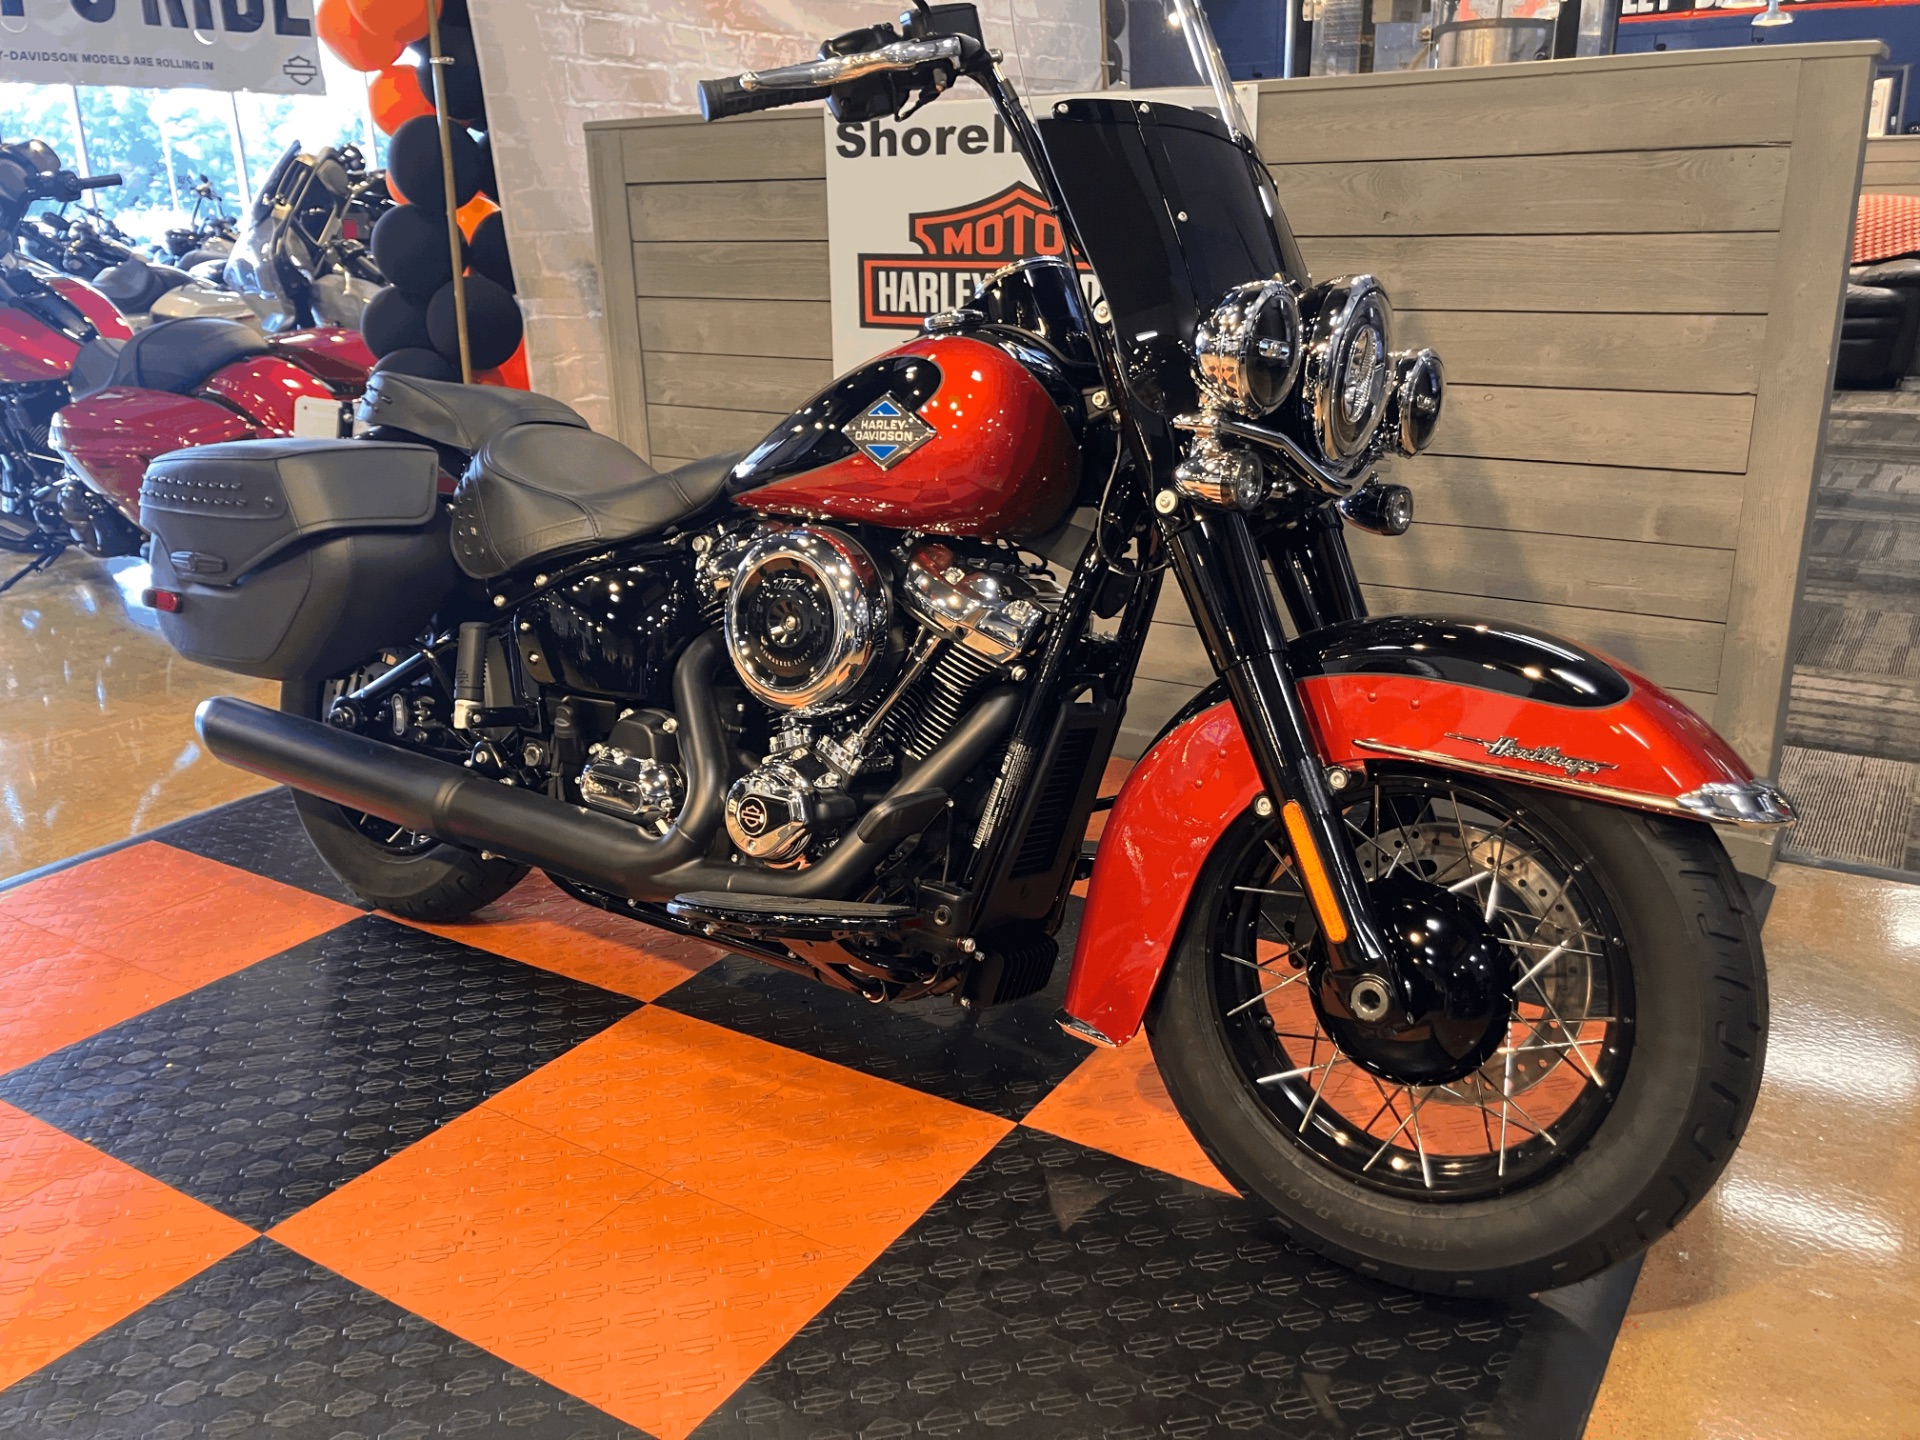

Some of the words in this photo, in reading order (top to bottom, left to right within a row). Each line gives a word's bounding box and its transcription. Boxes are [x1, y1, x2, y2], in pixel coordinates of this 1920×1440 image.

[81, 53, 130, 65] MODELS
[133, 56, 154, 67] ARE
[156, 57, 200, 70] ROLLING
[202, 61, 214, 70] IN
[943, 204, 1079, 256] MOTO
[855, 430, 914, 442] DAVIDSON
